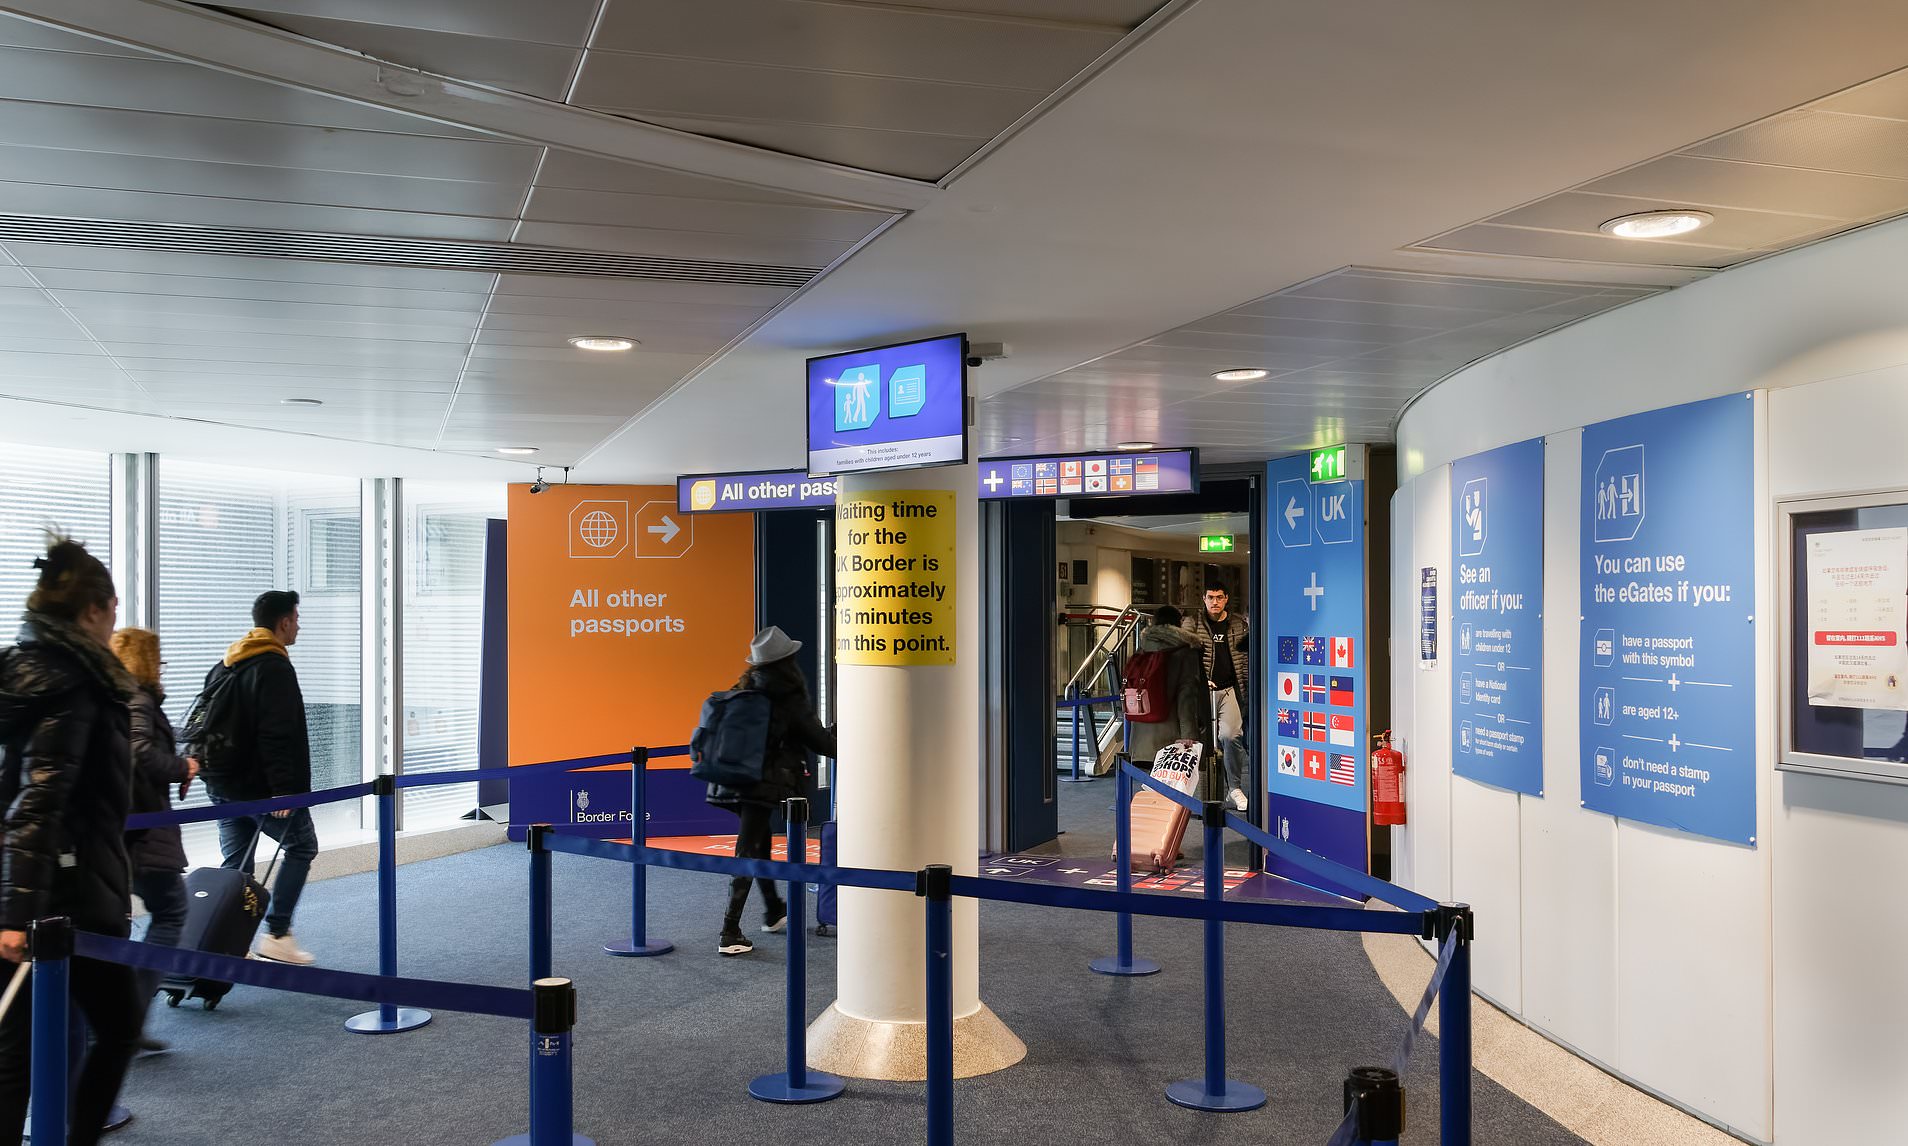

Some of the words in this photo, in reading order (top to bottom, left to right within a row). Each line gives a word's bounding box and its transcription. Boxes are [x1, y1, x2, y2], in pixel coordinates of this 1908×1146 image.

[721, 482, 743, 501] All
[748, 481, 795, 499] other
[892, 501, 937, 518] time
[1322, 494, 1345, 521] UK
[848, 529, 869, 545] for
[875, 528, 907, 545] the
[852, 555, 916, 572] Border
[923, 555, 939, 572] is
[1595, 555, 1620, 574] You
[1624, 556, 1651, 573] can
[1656, 555, 1685, 572] use
[1460, 564, 1476, 584] See
[1479, 567, 1491, 583] an
[569, 589, 599, 608] All
[606, 589, 667, 607] other
[836, 581, 946, 601] pproximately
[1594, 583, 1615, 603] the
[1619, 581, 1673, 603] eGates
[1678, 580, 1689, 602] if
[1692, 585, 1731, 607] you:
[1460, 590, 1489, 610] officer
[1491, 589, 1498, 610] if
[1500, 593, 1523, 614] you:
[855, 608, 933, 625] minutes
[571, 616, 685, 637] passports
[1502, 629, 1512, 639] with
[854, 635, 886, 651] this
[893, 635, 950, 655] point.
[1475, 642, 1491, 652] children
[1492, 643, 1504, 652] under
[1506, 643, 1512, 653] 12
[1622, 634, 1643, 647] have
[1644, 638, 1650, 648] a
[1652, 637, 1693, 651] passport
[1497, 661, 1505, 672] OR
[1622, 652, 1641, 664] with
[1642, 652, 1658, 666] this
[1660, 654, 1694, 669] symbol
[1475, 678, 1486, 688] have
[1489, 679, 1507, 691] National
[1490, 694, 1501, 705] card
[1497, 713, 1505, 723] OR
[1622, 705, 1636, 716] are
[1638, 706, 1660, 720] aged
[1662, 706, 1679, 720] 12+
[1475, 727, 1486, 736] need
[1489, 730, 1509, 741] passport
[1509, 732, 1525, 745] stamp
[1622, 756, 1645, 771] don't
[1646, 762, 1669, 775] need
[1671, 765, 1677, 776] a
[1679, 766, 1710, 783] stamp
[1622, 772, 1630, 785] in
[1632, 777, 1652, 789] your
[1653, 780, 1696, 797] passport
[577, 812, 616, 823] Border
[619, 810, 651, 821] Foe
